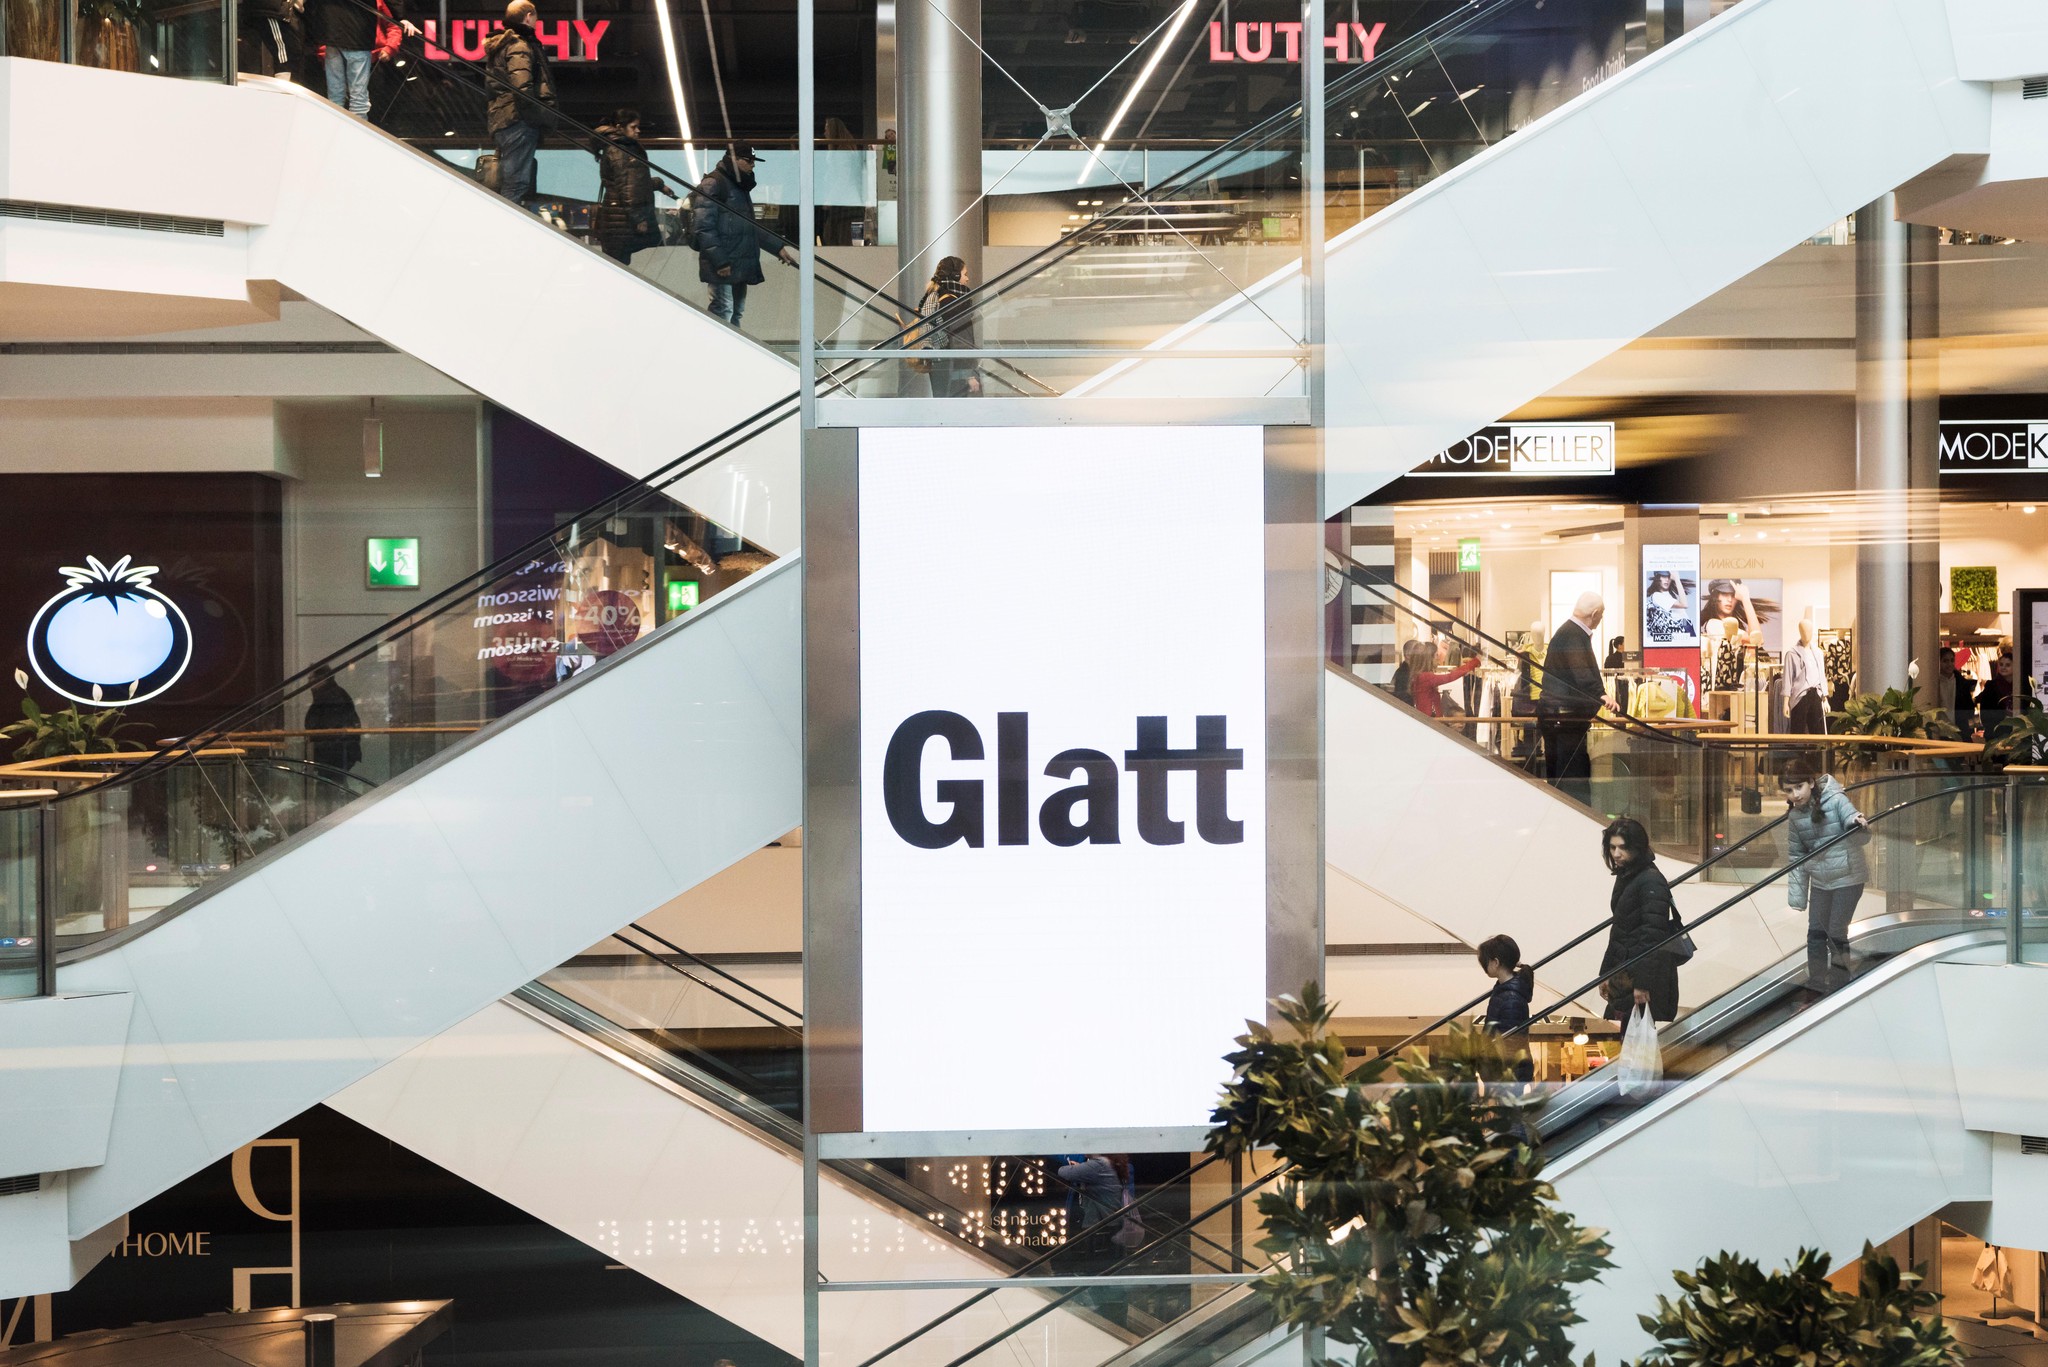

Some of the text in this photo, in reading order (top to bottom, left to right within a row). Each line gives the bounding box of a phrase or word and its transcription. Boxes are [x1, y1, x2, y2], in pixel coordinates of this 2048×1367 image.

[424, 19, 611, 61] LÜHY
[883, 709, 1244, 850] Glatt
[122, 1231, 211, 1257] HOME
